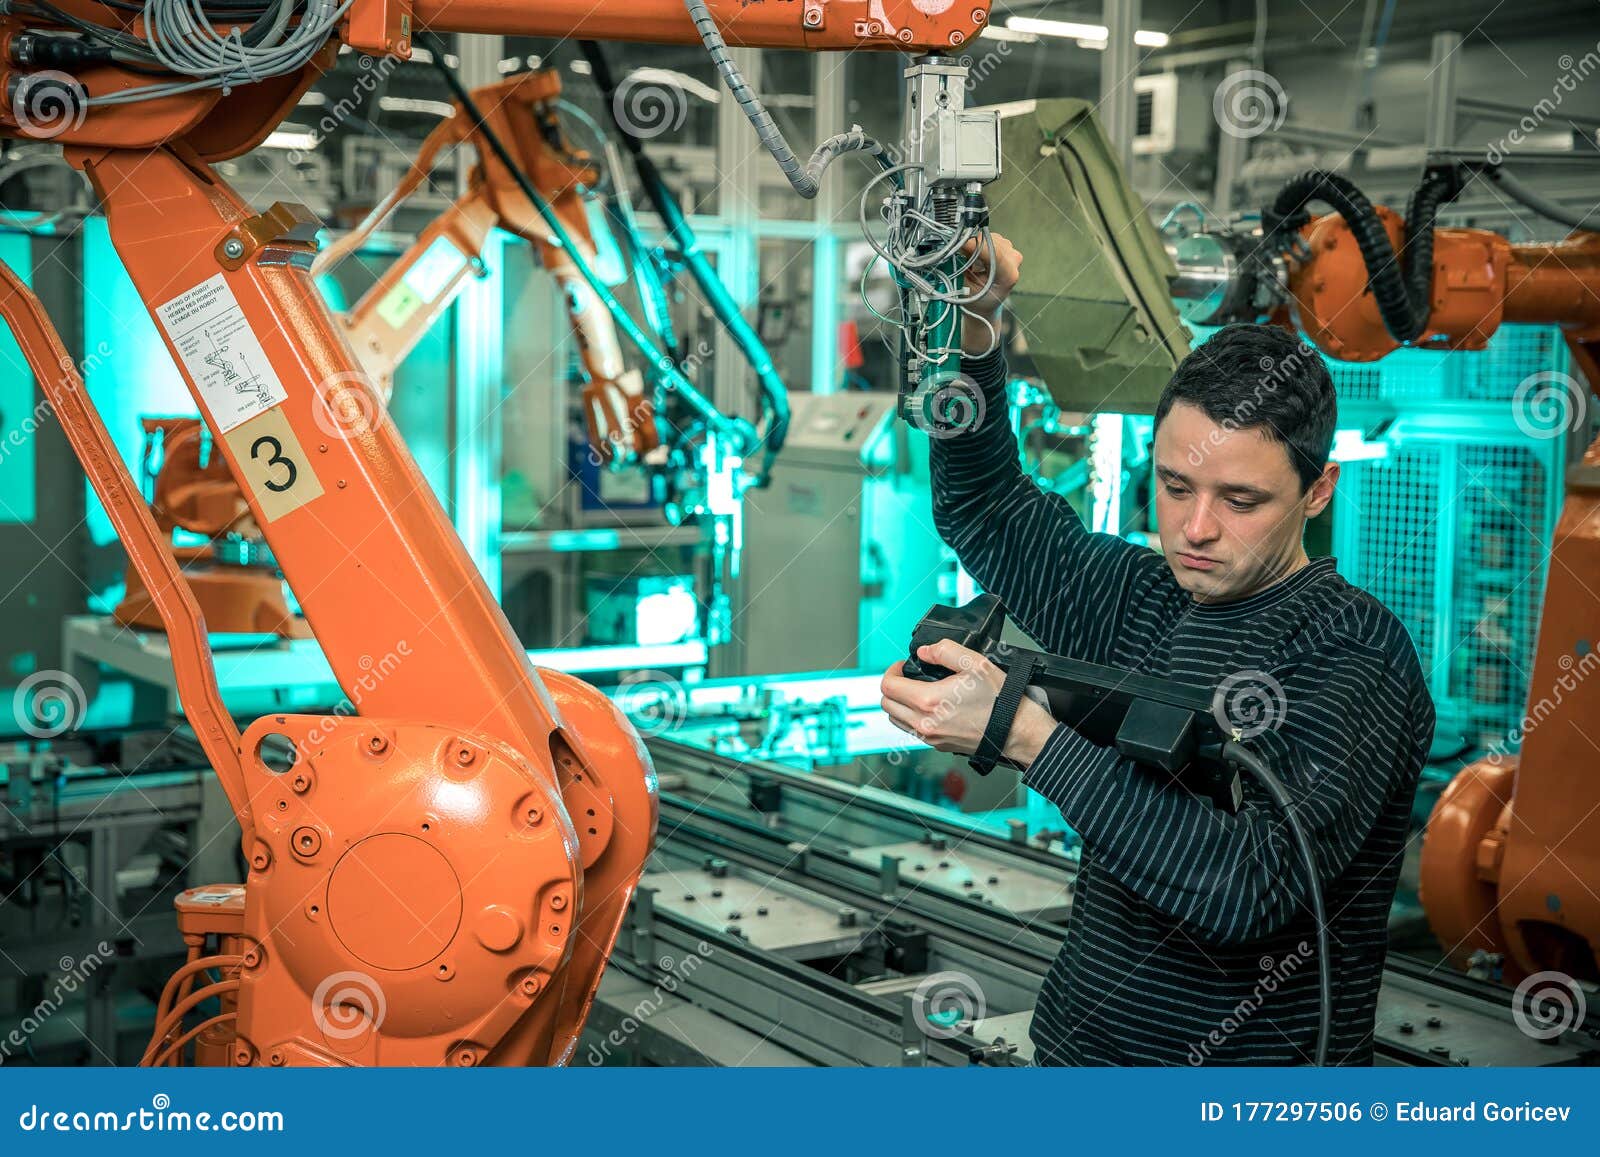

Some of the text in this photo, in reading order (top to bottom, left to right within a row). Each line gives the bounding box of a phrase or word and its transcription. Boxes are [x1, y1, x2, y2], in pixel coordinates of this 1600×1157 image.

[164, 284, 209, 313] LIFTING OF ROBOT
[168, 285, 225, 319] HEBEN DES ROBOTERS
[171, 297, 217, 326] LEVAGE DU ROBOT
[250, 435, 298, 493] 3
